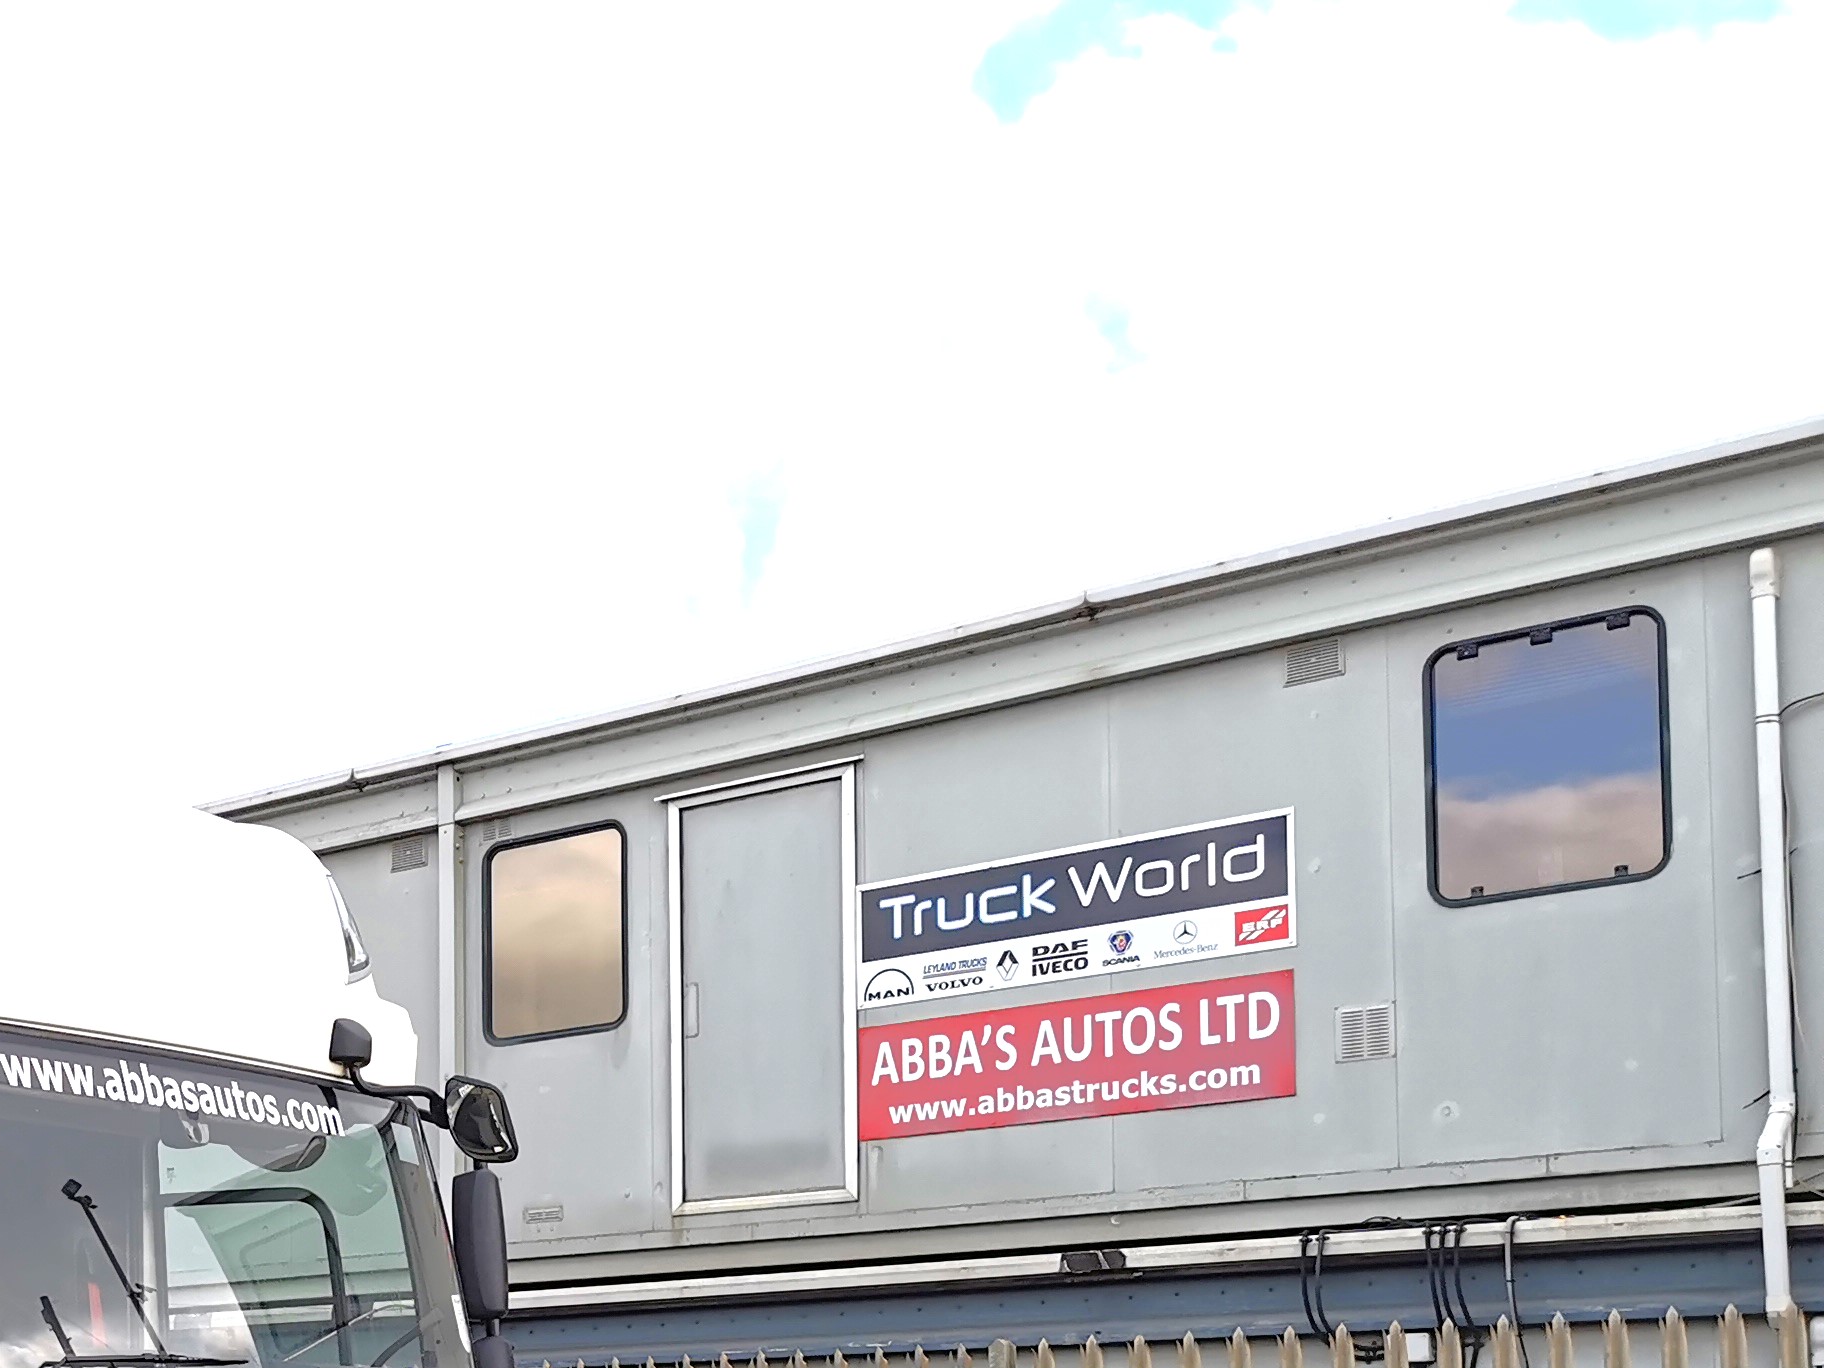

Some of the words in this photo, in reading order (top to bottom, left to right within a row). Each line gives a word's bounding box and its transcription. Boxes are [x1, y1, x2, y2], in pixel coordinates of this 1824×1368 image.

[878, 873, 1057, 941] Truck
[1066, 833, 1267, 909] World
[1031, 938, 1089, 957] DAF
[1153, 942, 1219, 960] Mercedes-Benz
[922, 960, 957, 975] LEYLAND
[958, 956, 988, 970] TRUCKS
[1031, 956, 1089, 977] IVECO
[1102, 955, 1141, 968] SCANIA
[925, 975, 984, 993] VOLVO
[867, 986, 911, 1002] MAN
[870, 1022, 1018, 1087] ABBA'S
[1030, 1003, 1184, 1069] AUTOS
[1199, 989, 1281, 1046] LTD
[887, 1063, 1262, 1125] www.abbastrucks.com
